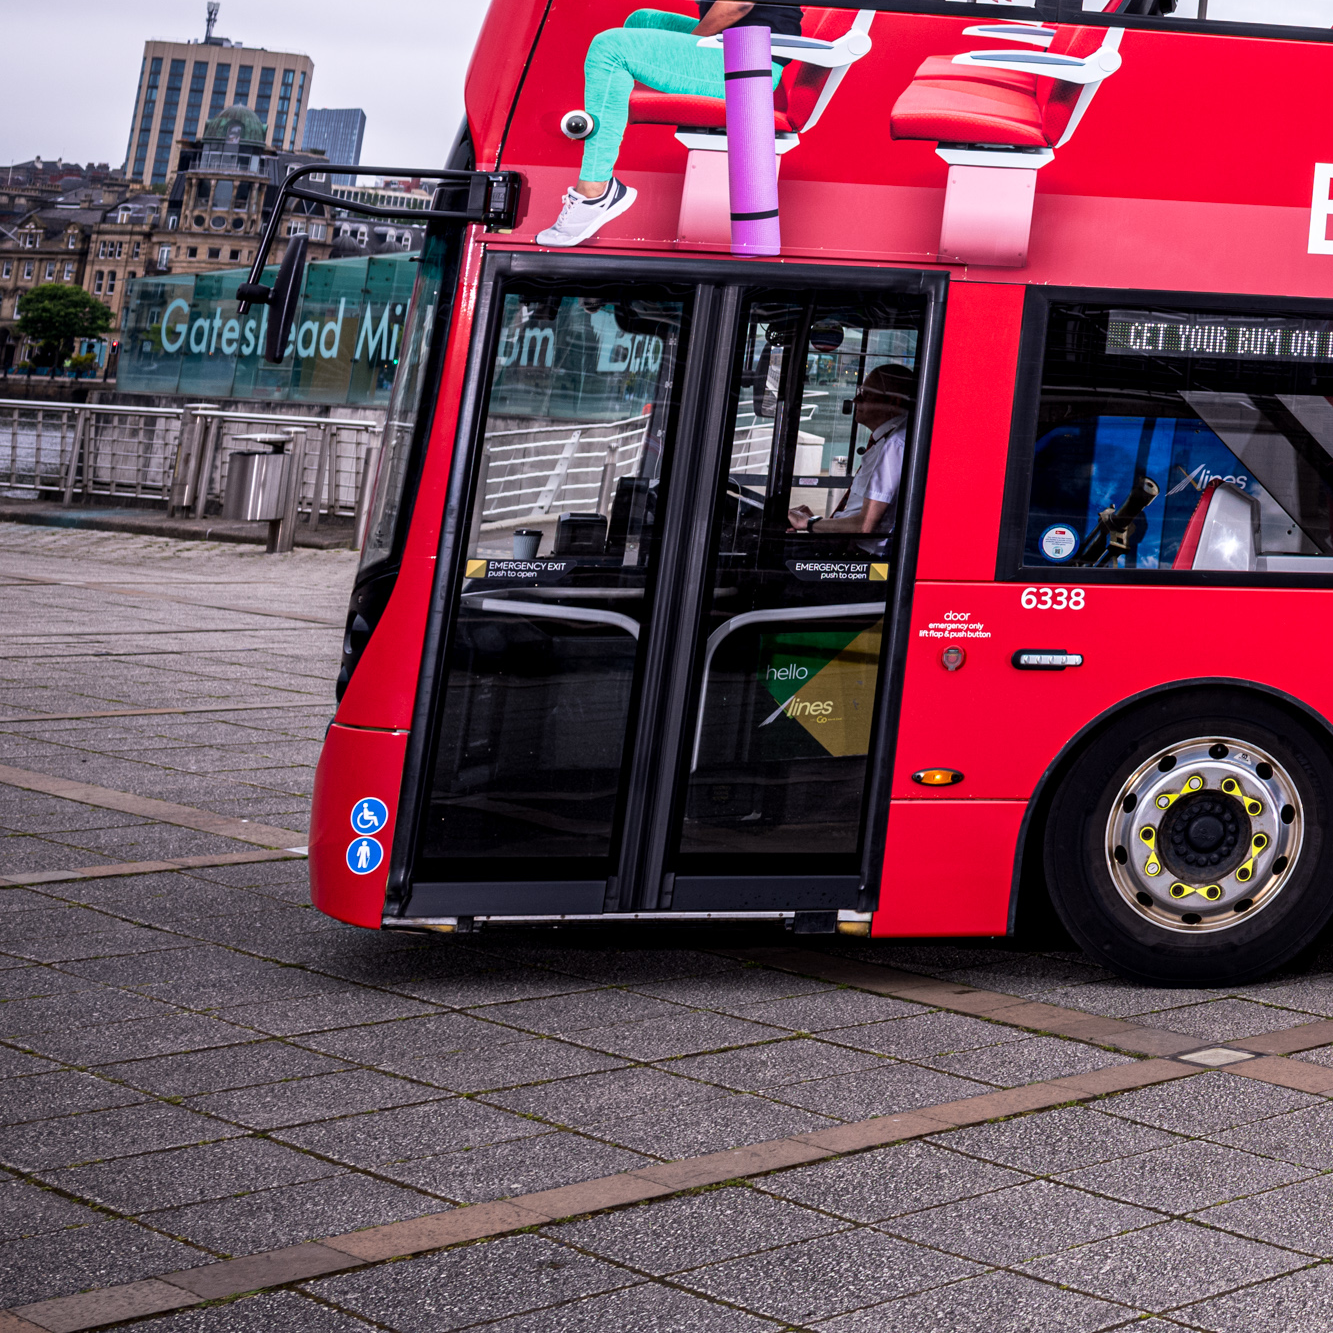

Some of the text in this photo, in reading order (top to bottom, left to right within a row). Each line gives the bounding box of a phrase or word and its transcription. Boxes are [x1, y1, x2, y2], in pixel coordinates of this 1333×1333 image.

[1130, 323, 1168, 350] GET
[1179, 325, 1228, 353] YOUR
[1238, 327, 1282, 355] BUM
[1291, 330, 1319, 357] ON
[488, 561, 566, 571] EMERGENCY EXIT
[795, 563, 868, 572] EMERGENCY EXIT
[488, 570, 507, 578] push
[821, 571, 838, 579] push
[1021, 587, 1085, 610] 6338
[944, 611, 971, 621] door
[928, 622, 984, 631] emergency only
[929, 630, 943, 639] flap
[950, 631, 967, 639] push
[765, 663, 808, 680] hello
